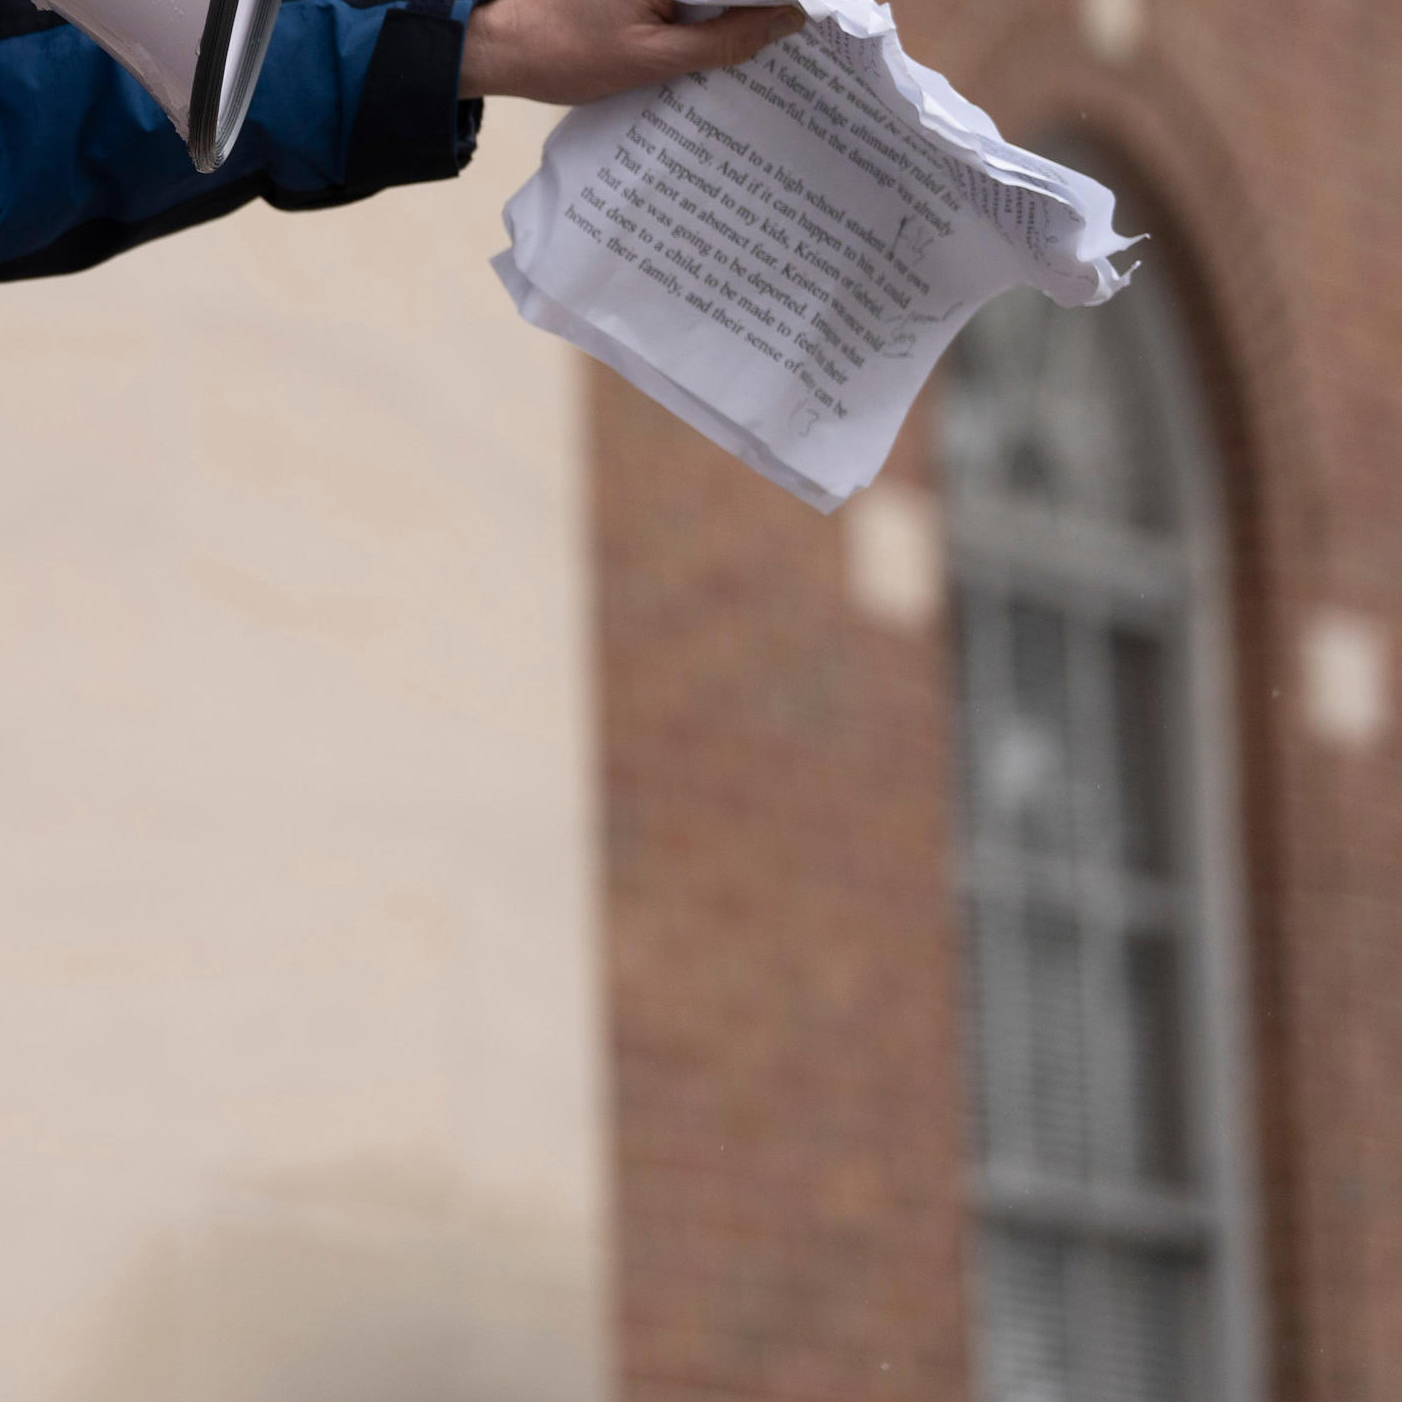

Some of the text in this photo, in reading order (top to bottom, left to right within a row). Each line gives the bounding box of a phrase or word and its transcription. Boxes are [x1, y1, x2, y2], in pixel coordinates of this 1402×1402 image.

[657, 84, 686, 114] This
[685, 106, 748, 156] happened
[749, 150, 763, 167] to
[762, 163, 773, 174] a
[773, 166, 805, 195] high
[805, 189, 846, 223] school
[845, 217, 885, 254] student
[762, 58, 776, 73] A
[777, 66, 816, 103] federal
[814, 100, 848, 127] judge
[850, 123, 910, 173] ultimately
[807, 116, 828, 141] but
[828, 133, 847, 155] the
[848, 145, 897, 189] damage
[597, 166, 623, 192] that
[621, 186, 645, 208] she
[647, 204, 672, 227] was
[670, 224, 713, 257] going
[713, 249, 728, 265] to
[728, 257, 747, 277] be
[747, 272, 807, 319] deported.
[613, 145, 642, 175] That
[642, 169, 655, 185] is
[655, 179, 681, 201] not
[679, 197, 698, 214] an
[697, 210, 750, 249] abstract
[749, 242, 779, 271] fear.
[781, 261, 830, 303] Kristen
[863, 329, 886, 353] told
[626, 124, 656, 155] have
[656, 149, 722, 200] happened
[720, 192, 736, 210] to
[736, 204, 760, 226] my
[759, 217, 790, 249] kids,
[794, 240, 841, 280] Kristen
[717, 161, 747, 186] And
[747, 179, 762, 196] if
[760, 188, 773, 203] it
[772, 198, 797, 220] can
[797, 213, 842, 252] happen
[843, 244, 857, 261] to
[564, 203, 848, 419] home, their family, and their sense of can be
[580, 185, 607, 211] that
[606, 207, 637, 234] does
[638, 228, 653, 244] to
[654, 241, 664, 252] a
[664, 247, 702, 279] child,
[703, 272, 719, 289] to
[719, 281, 737, 301] be
[737, 295, 776, 327] made
[776, 321, 792, 338] to
[794, 331, 818, 356] feel
[823, 360, 848, 386] their
